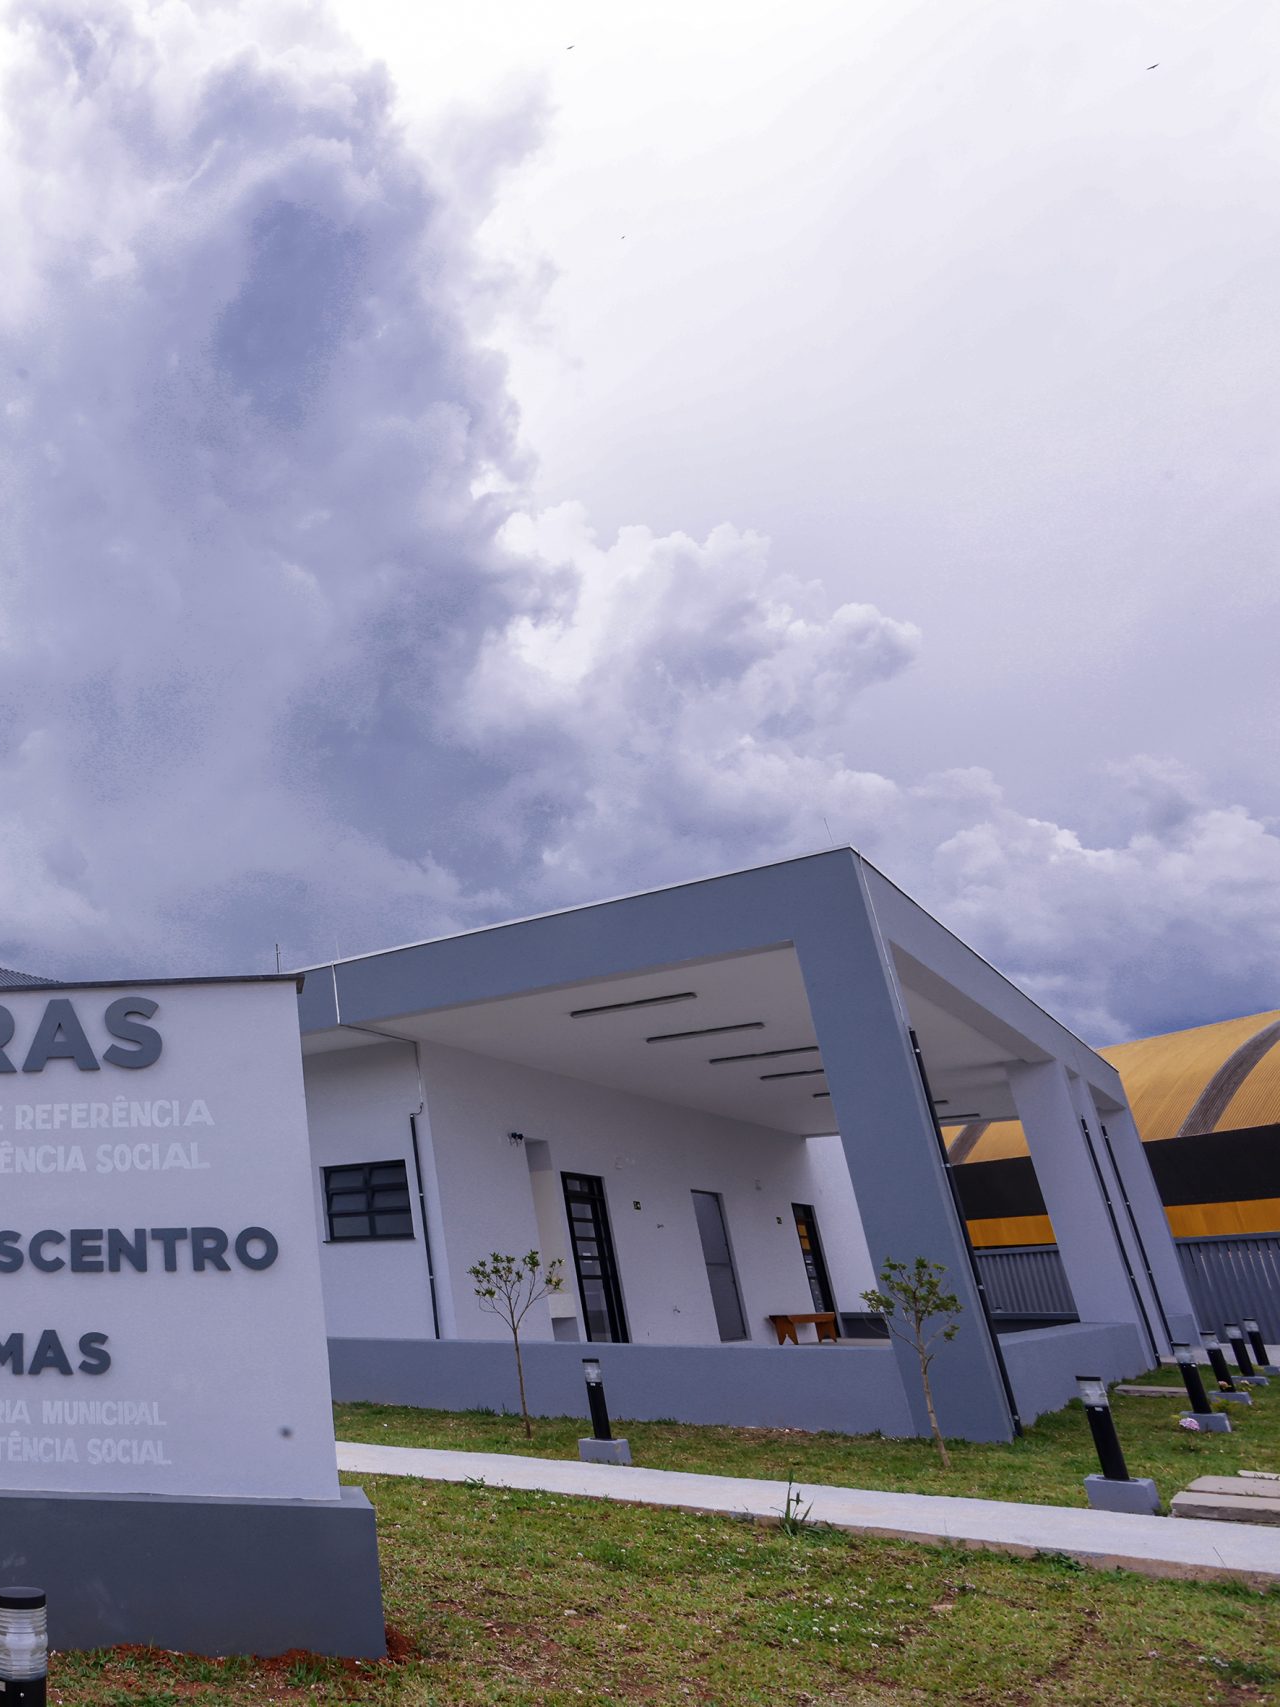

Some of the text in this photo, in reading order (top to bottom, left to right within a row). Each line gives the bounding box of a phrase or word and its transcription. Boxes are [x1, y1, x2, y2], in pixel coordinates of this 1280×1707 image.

[15, 1095, 216, 1130] REFERÊNCIA
[95, 1142, 211, 1174] SOCIAL
[42, 1400, 167, 1426] MUNICIPAL
[87, 1438, 172, 1465] SOCIAL
